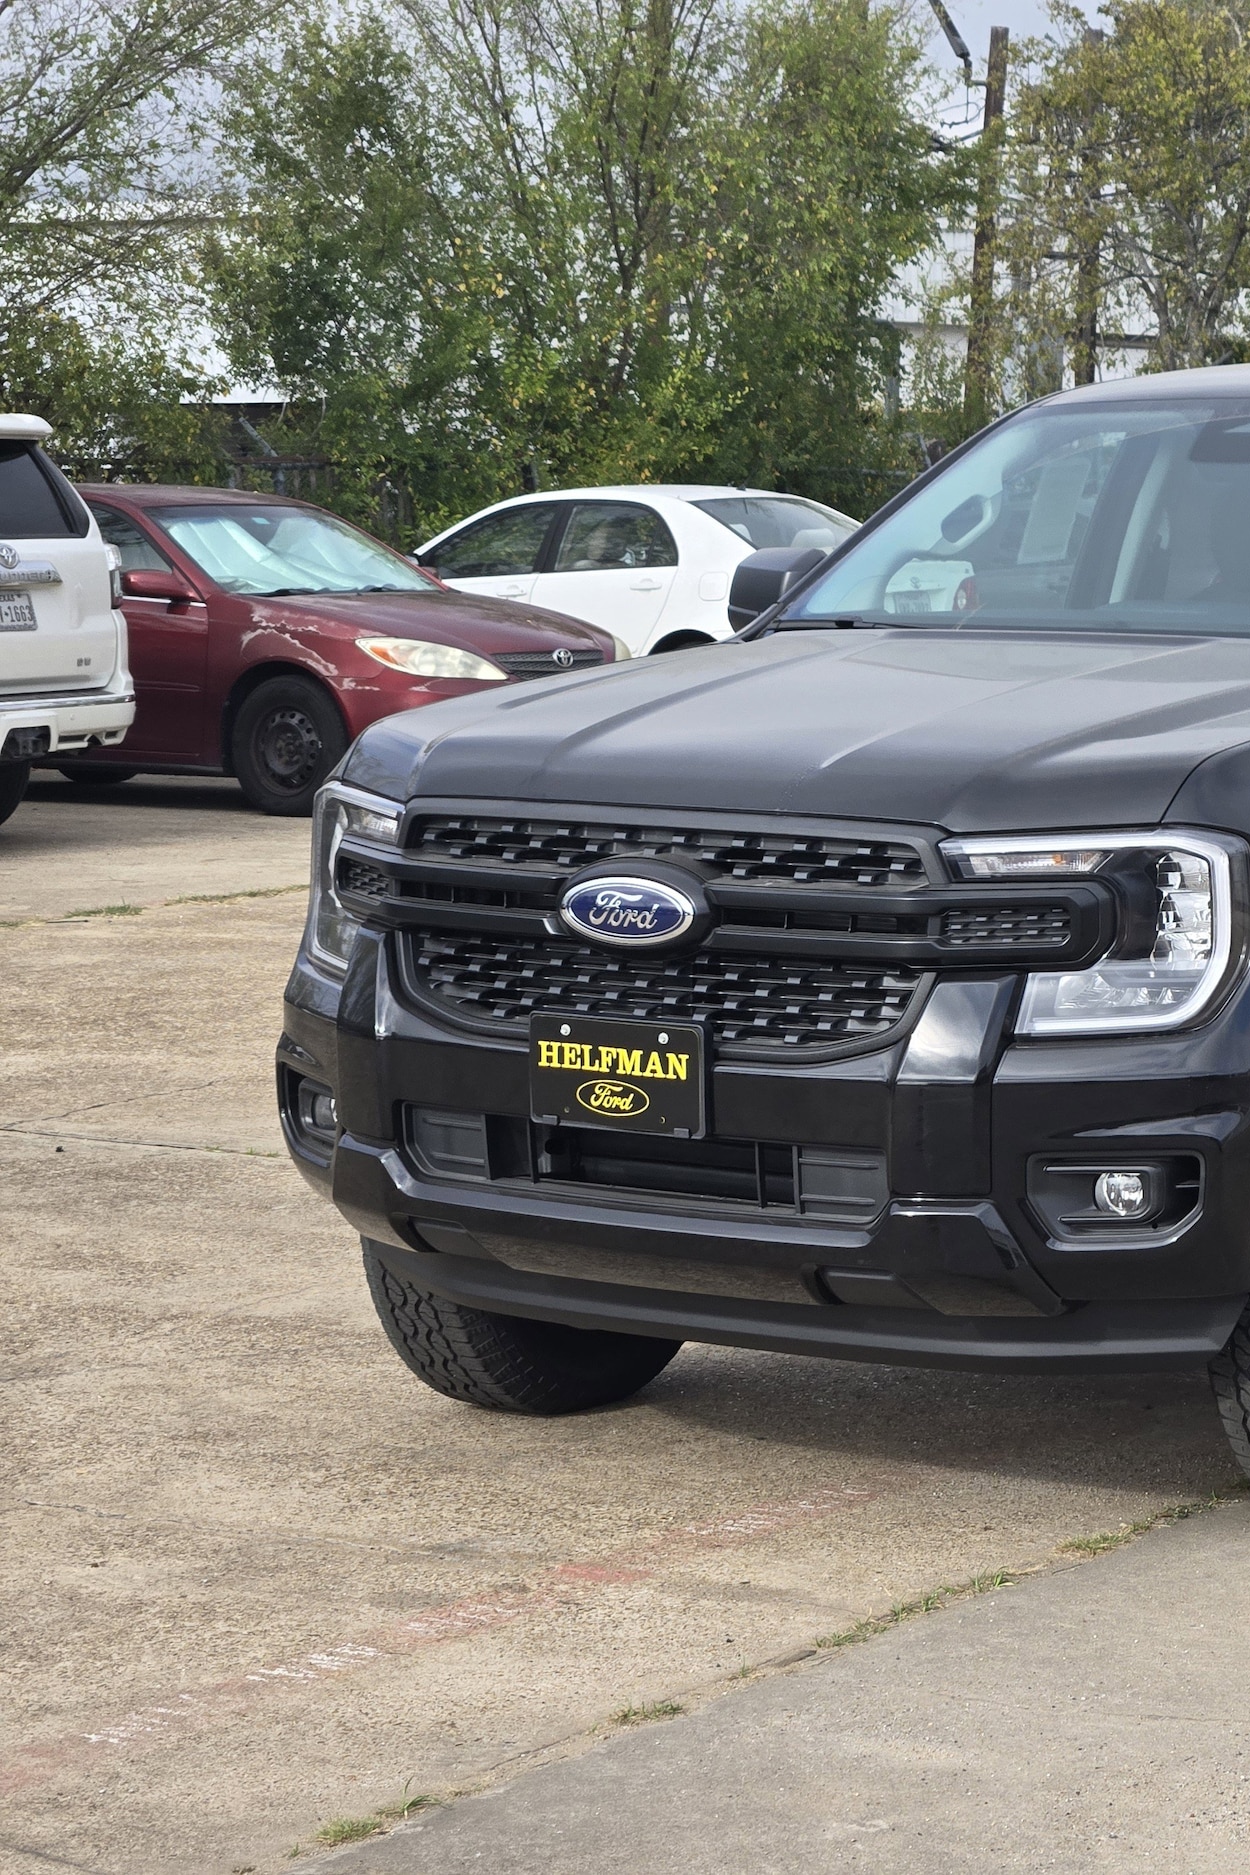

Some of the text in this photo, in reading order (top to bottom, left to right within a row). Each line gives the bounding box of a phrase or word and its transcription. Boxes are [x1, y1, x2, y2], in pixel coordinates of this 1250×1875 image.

[588, 889, 660, 931] Ford
[537, 1040, 690, 1081] HELFMAN
[590, 1081, 635, 1112] Ford
